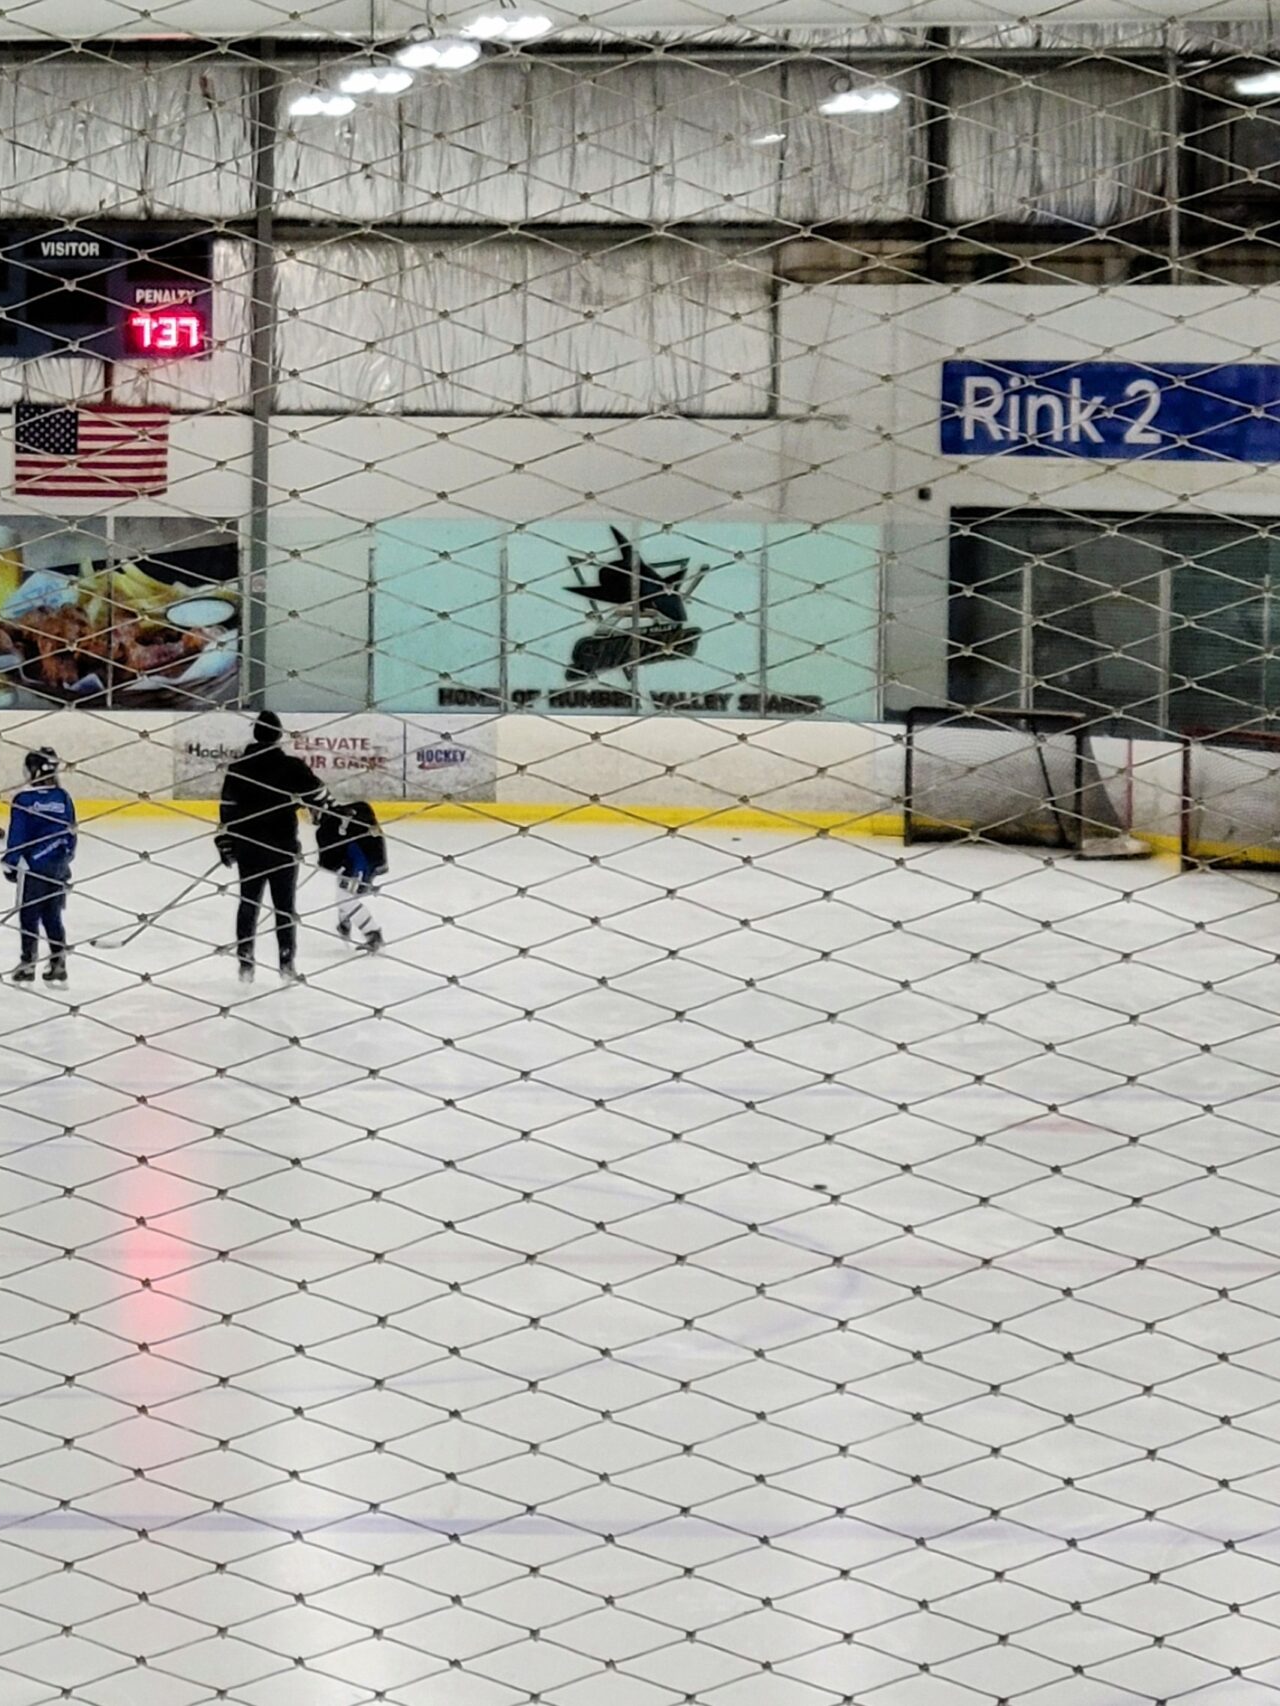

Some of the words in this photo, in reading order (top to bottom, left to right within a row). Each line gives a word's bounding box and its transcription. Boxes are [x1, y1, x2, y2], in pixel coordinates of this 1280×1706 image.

[41, 242, 100, 257] VISITOR
[135, 289, 195, 304] PENALTY
[964, 375, 1106, 443] Rink
[1124, 379, 1162, 444] 2
[417, 749, 466, 763] HOCKEY
